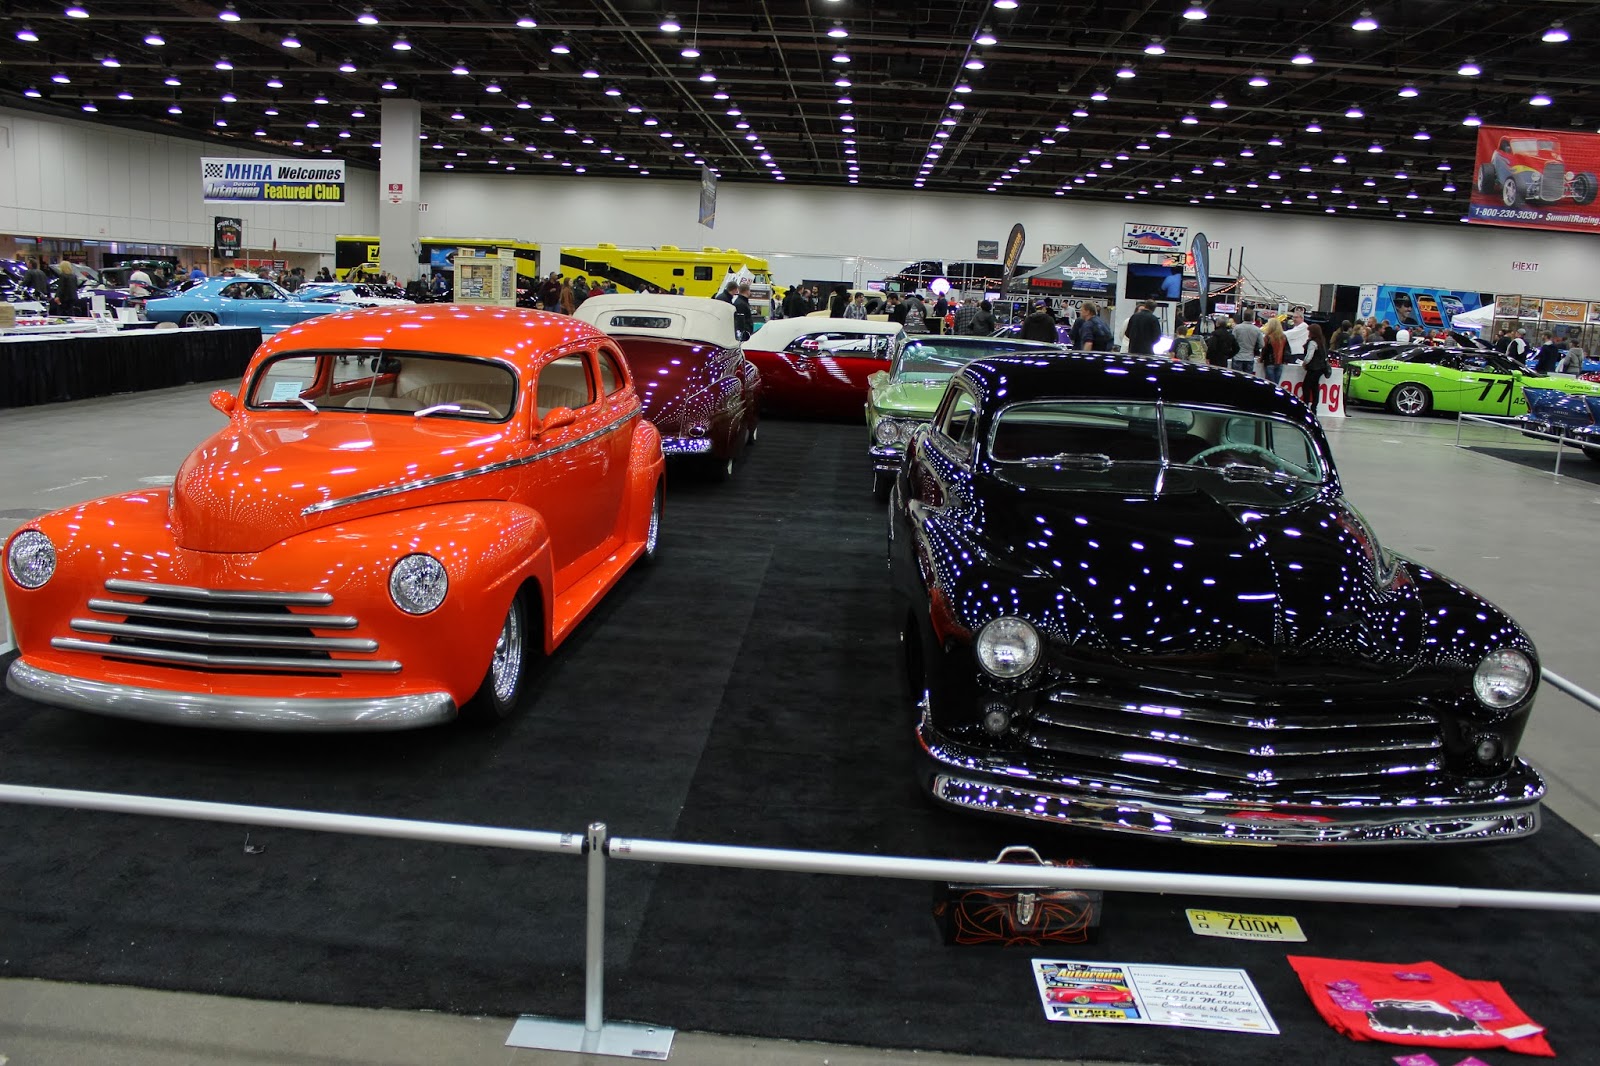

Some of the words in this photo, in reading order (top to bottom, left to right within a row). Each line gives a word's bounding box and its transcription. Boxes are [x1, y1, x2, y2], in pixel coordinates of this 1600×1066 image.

[225, 163, 273, 180] MHRA
[277, 166, 342, 180] Welcomes
[204, 183, 260, 198] Autorama
[264, 183, 313, 199] Featured
[314, 184, 340, 200] Club
[1474, 207, 1538, 220] 1-800-230-3030
[1520, 262, 1539, 271] EXIT
[1369, 363, 1399, 372] Dodge
[1477, 377, 1512, 403] 77
[1224, 917, 1282, 935] ZOOM
[1199, 997, 1253, 1007] Mercury
